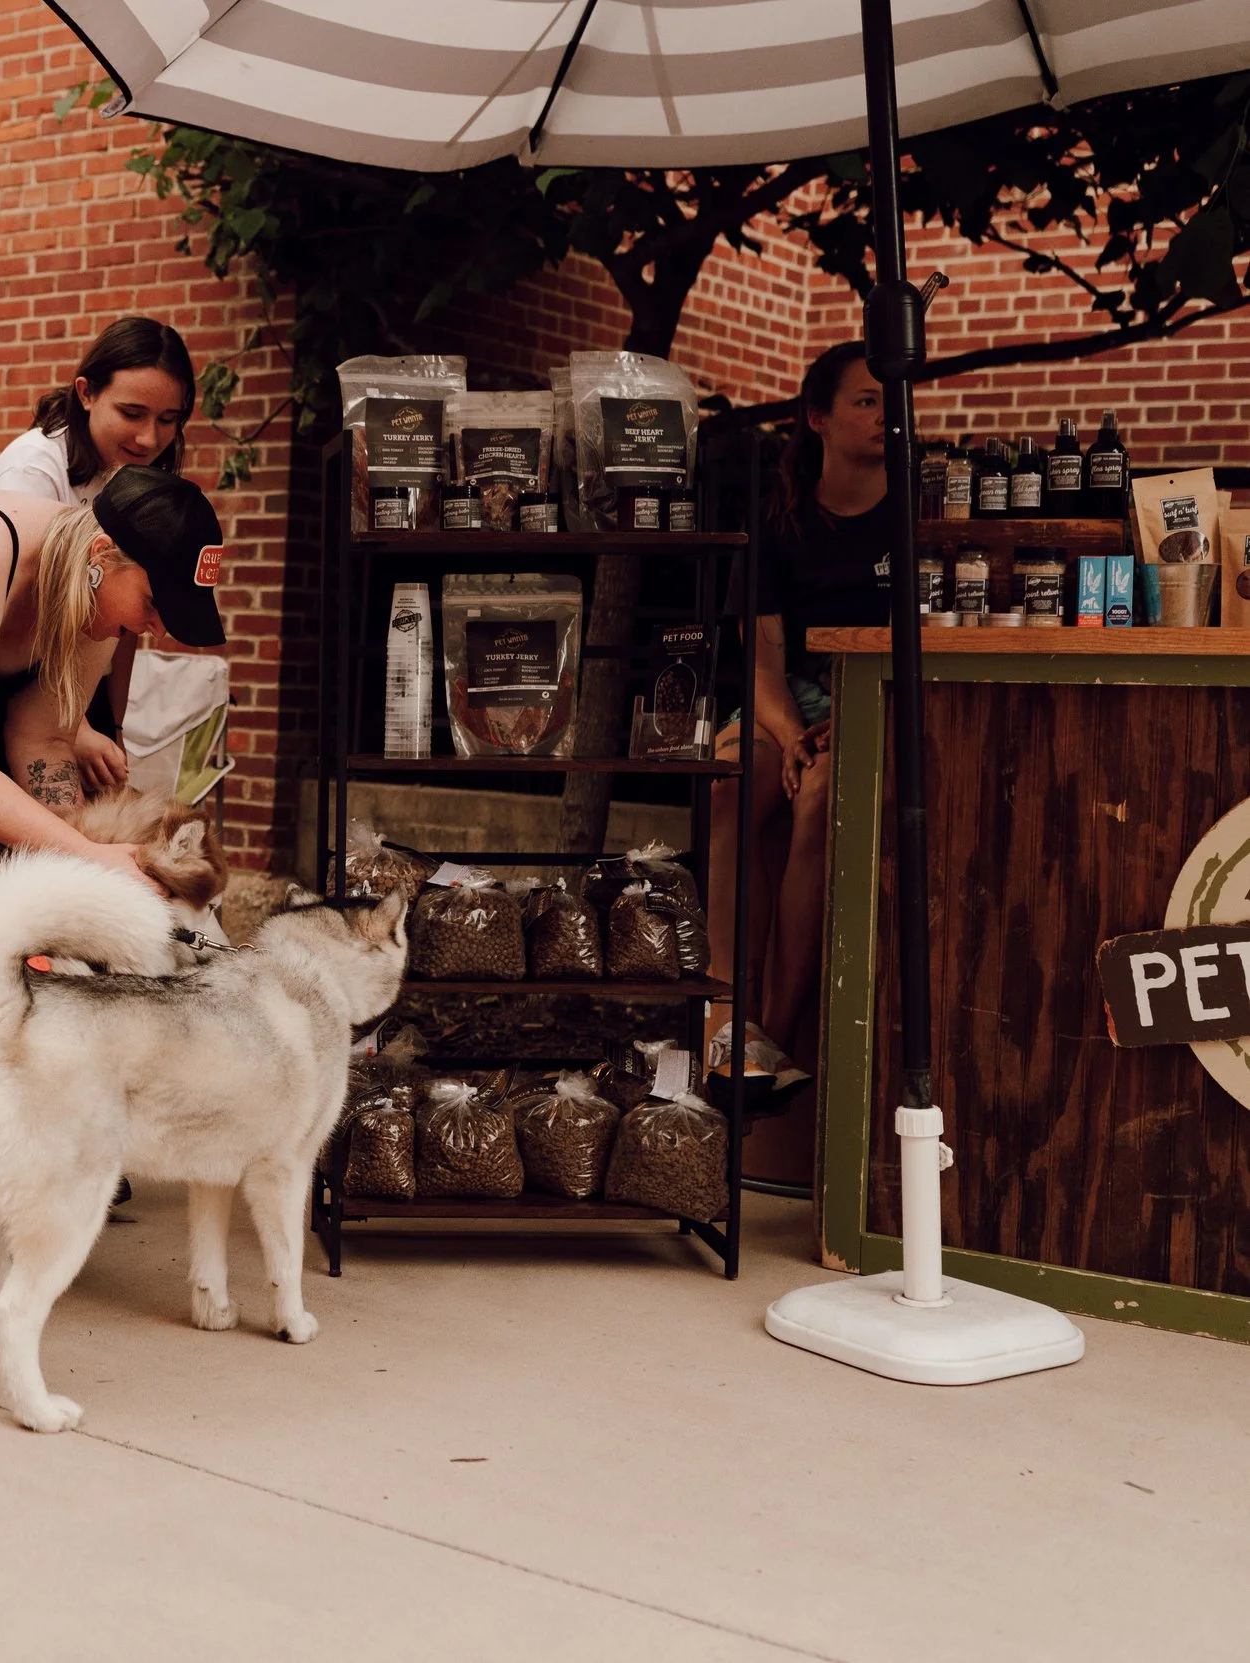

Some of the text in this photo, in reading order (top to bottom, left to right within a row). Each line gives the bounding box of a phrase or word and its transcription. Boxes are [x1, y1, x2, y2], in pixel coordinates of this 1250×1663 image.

[641, 428, 664, 436] HEART
[478, 452, 504, 460] CHICKEN
[1062, 467, 1080, 476] spray
[1104, 465, 1122, 474] spray
[1163, 509, 1177, 519] surf
[1185, 504, 1199, 515] turf
[1024, 590, 1039, 600] joint
[663, 632, 703, 642] PET FOOD
[485, 653, 539, 661] TURKEY JERKY
